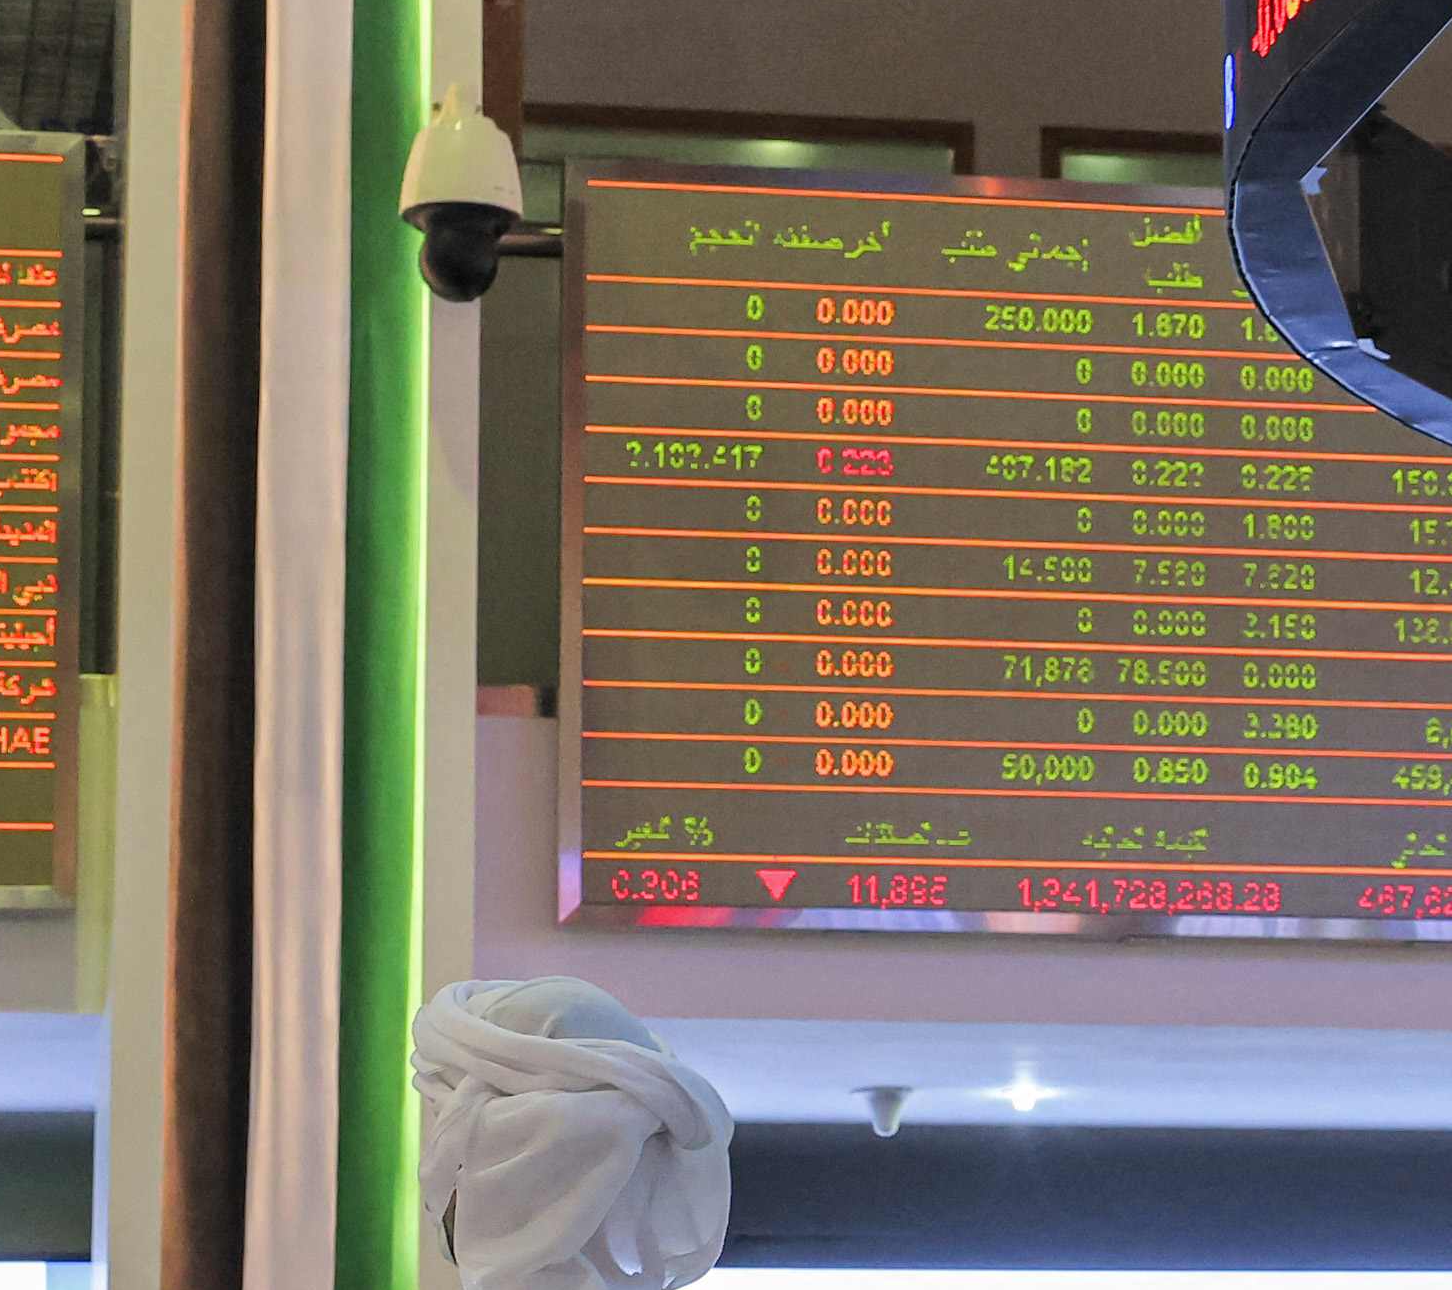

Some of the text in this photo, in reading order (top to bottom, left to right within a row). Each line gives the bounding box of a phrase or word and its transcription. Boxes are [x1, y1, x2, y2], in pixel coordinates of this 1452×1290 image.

[746, 294, 765, 320] 0
[816, 297, 895, 326] 0.000
[815, 701, 894, 729] 0.000
[1134, 710, 1208, 736] 0.000
[815, 749, 895, 778] 0.000
